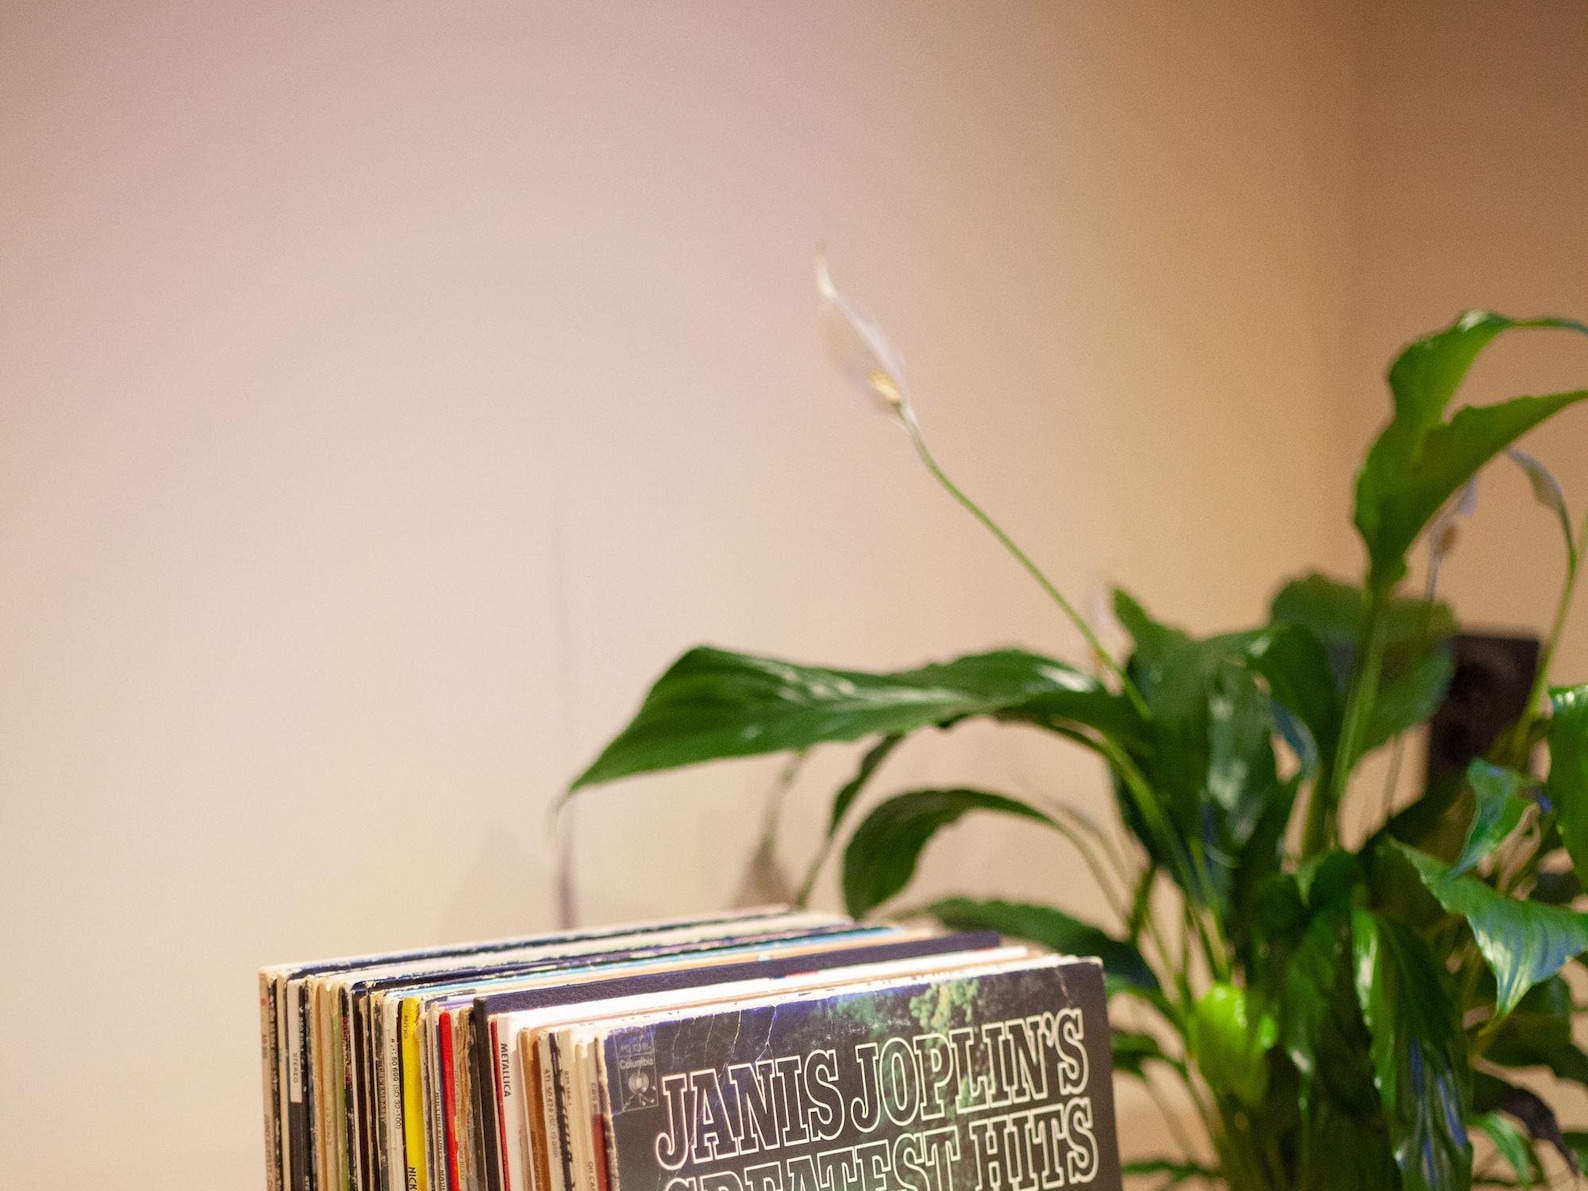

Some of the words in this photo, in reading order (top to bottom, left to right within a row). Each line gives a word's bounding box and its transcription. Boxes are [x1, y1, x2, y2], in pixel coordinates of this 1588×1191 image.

[500, 1042, 512, 1098] METALLICA
[620, 1055, 655, 1071] Columbia
[655, 1048, 846, 1172] JANIS
[850, 1007, 1090, 1133] JOPLIN'S
